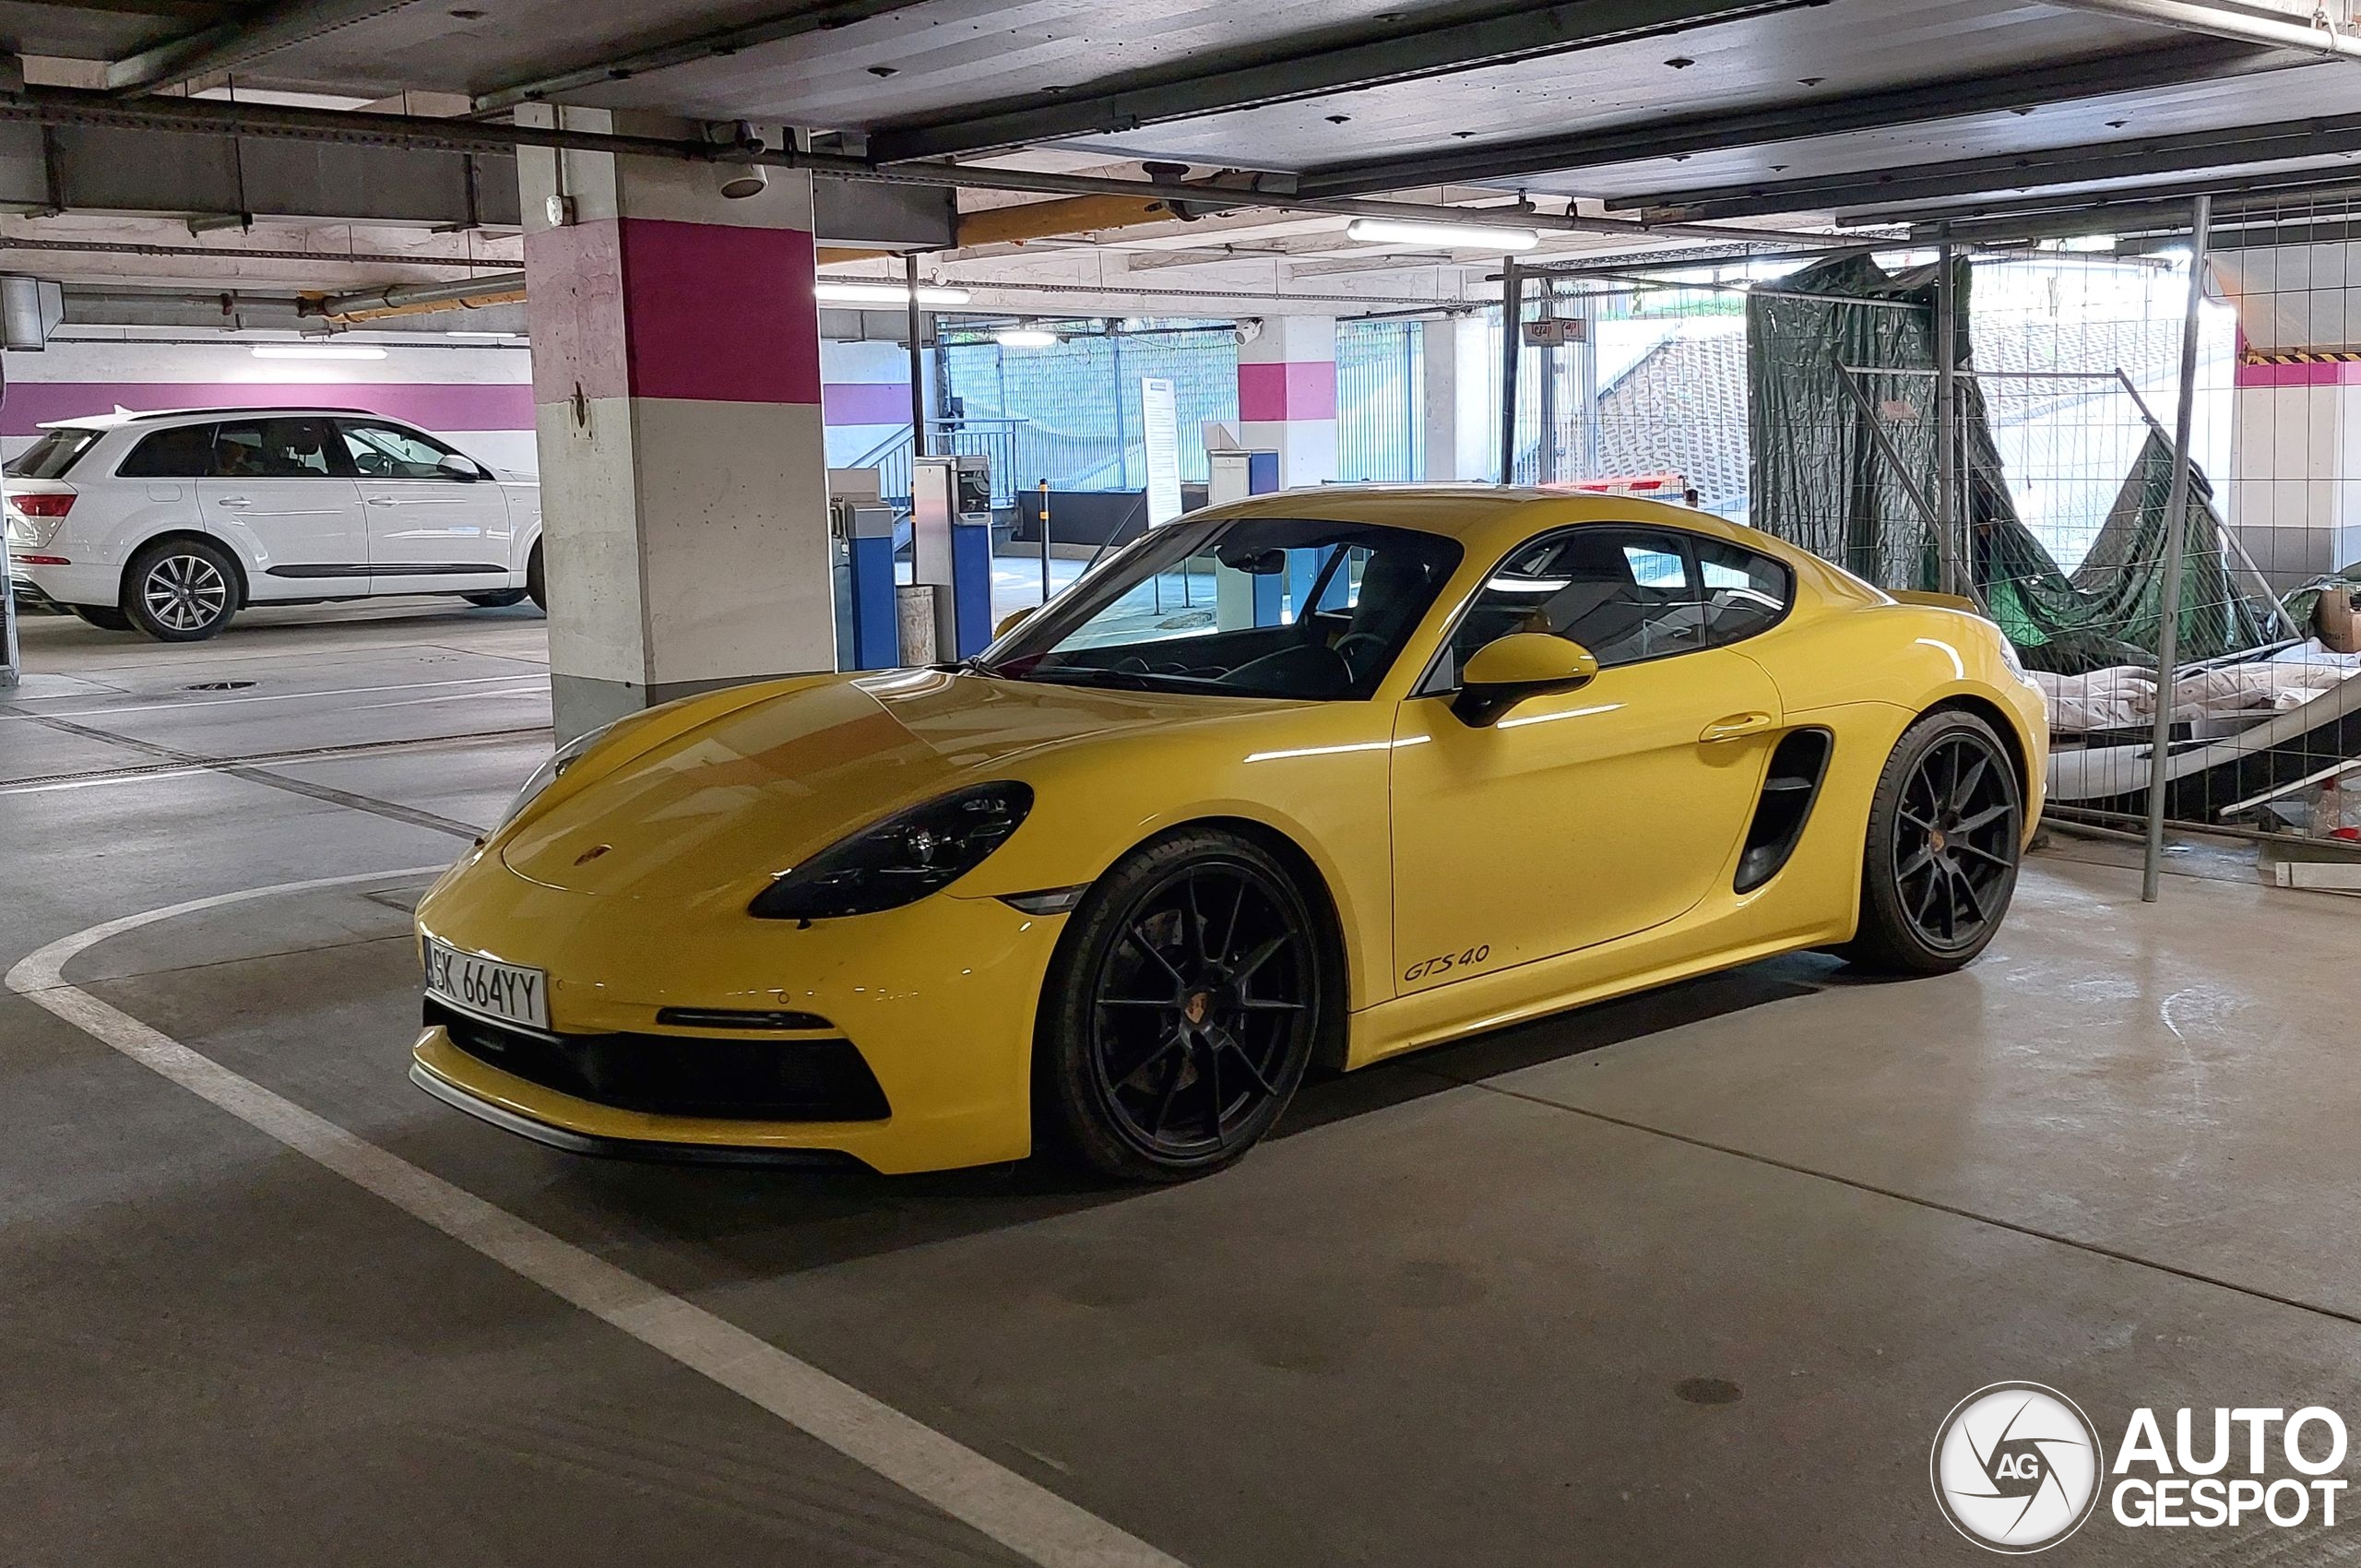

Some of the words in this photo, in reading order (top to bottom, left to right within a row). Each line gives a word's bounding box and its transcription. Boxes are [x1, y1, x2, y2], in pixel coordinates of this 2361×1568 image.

[433, 947, 457, 997] SK
[463, 959, 536, 1020] 664YY
[1404, 953, 1455, 981] GTS
[1458, 944, 1489, 966] 4.0
